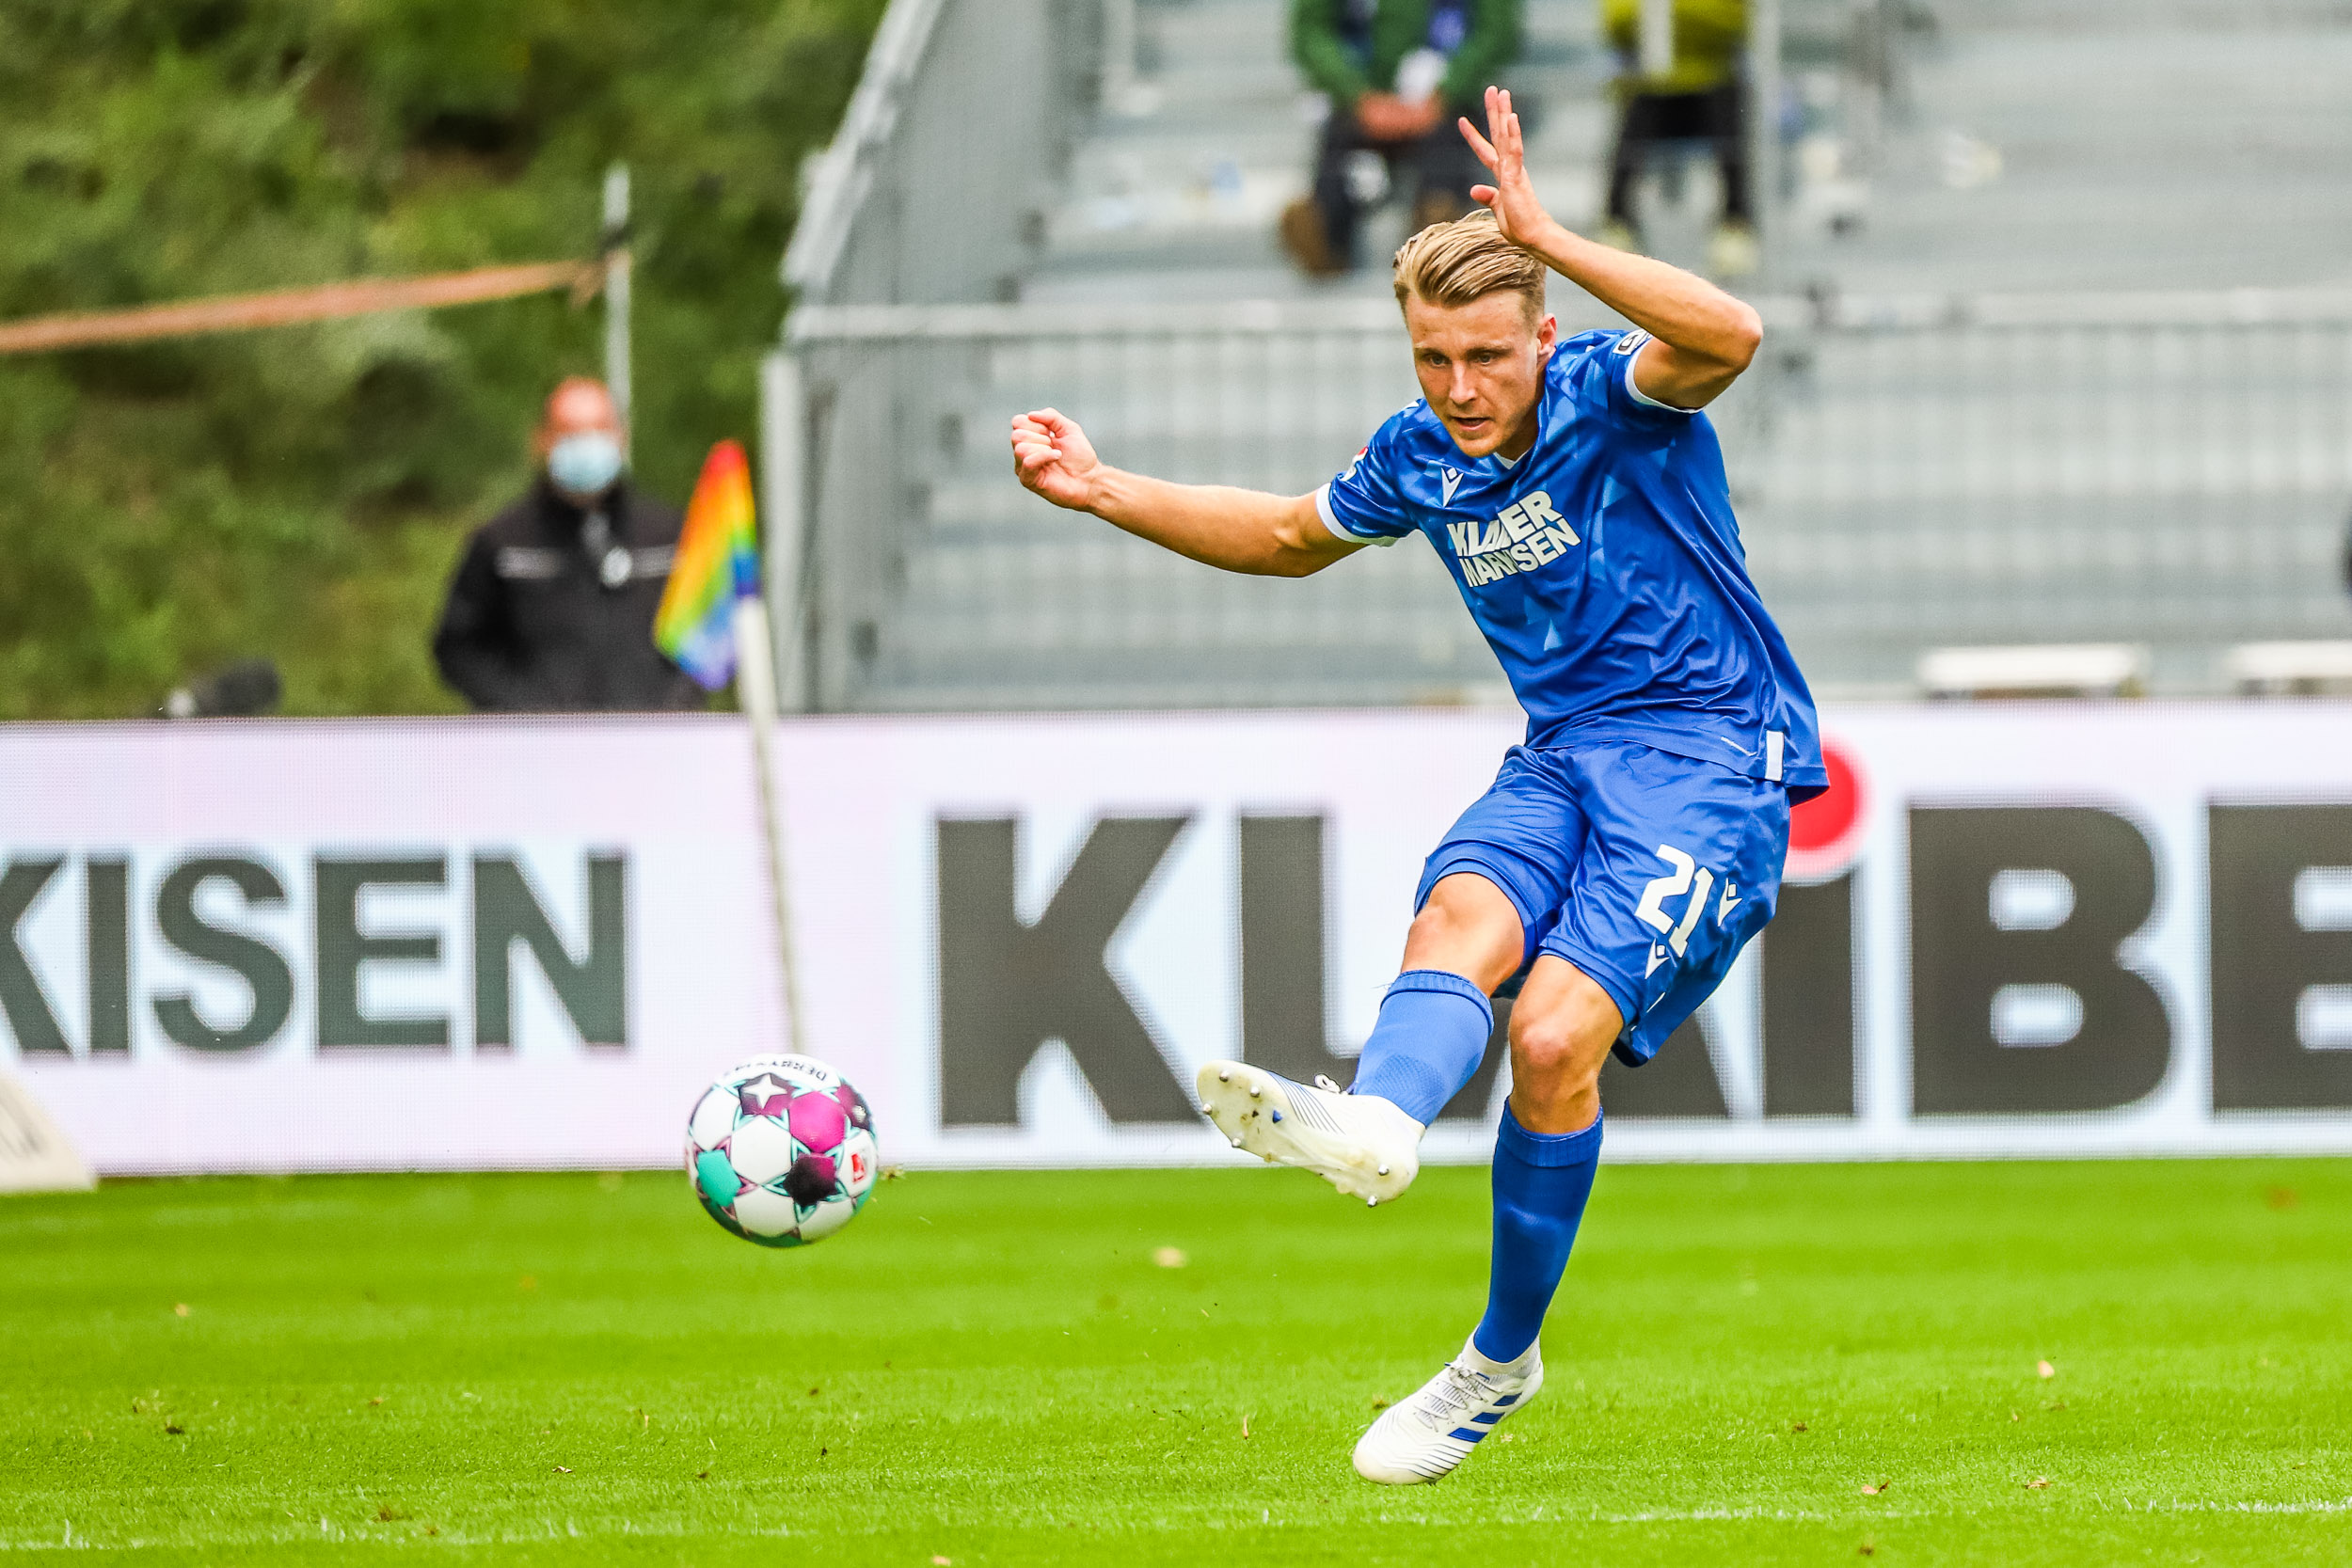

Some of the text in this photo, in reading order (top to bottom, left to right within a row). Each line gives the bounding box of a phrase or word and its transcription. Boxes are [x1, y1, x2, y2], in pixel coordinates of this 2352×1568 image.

[1446, 490, 1564, 557] KLAER
[1458, 518, 1582, 588] MARKSEN
[1634, 843, 1714, 958] 21
